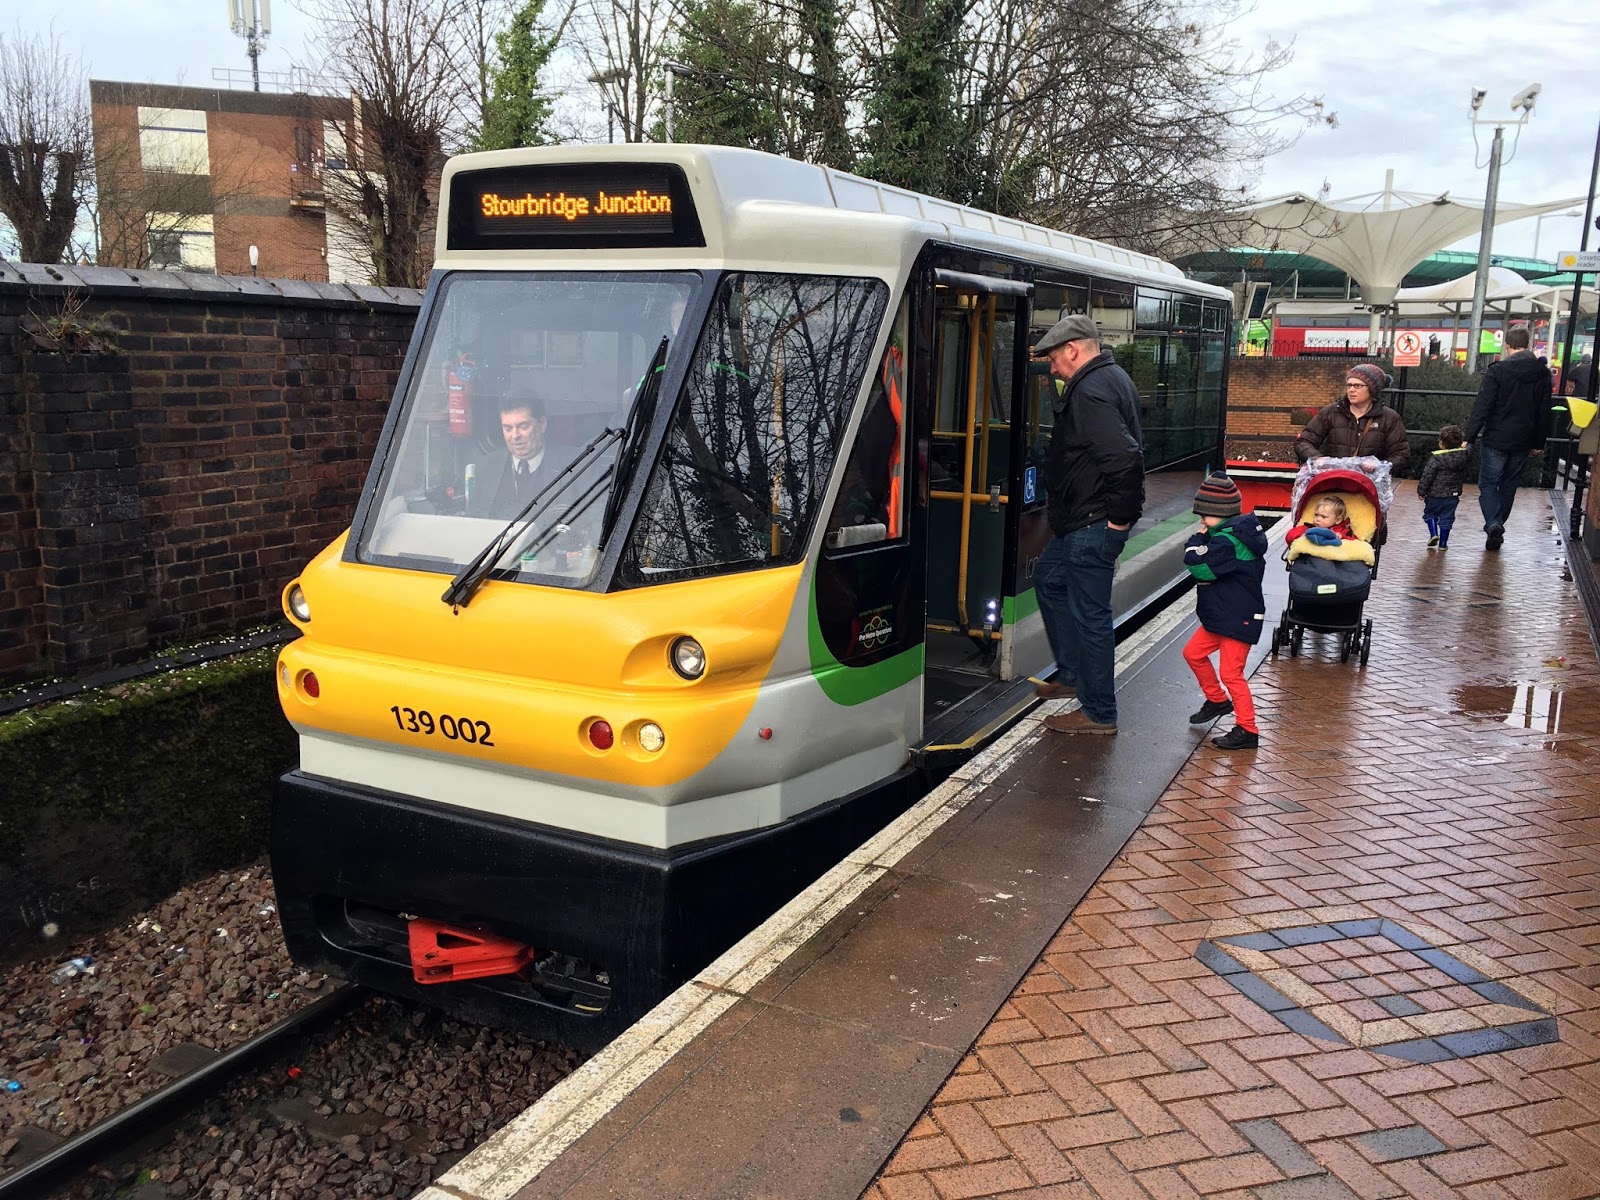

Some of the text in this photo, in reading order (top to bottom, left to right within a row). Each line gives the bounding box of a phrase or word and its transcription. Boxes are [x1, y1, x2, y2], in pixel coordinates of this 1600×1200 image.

[481, 190, 672, 220] Stourbridge Junction
[390, 705, 495, 747] 139 002
